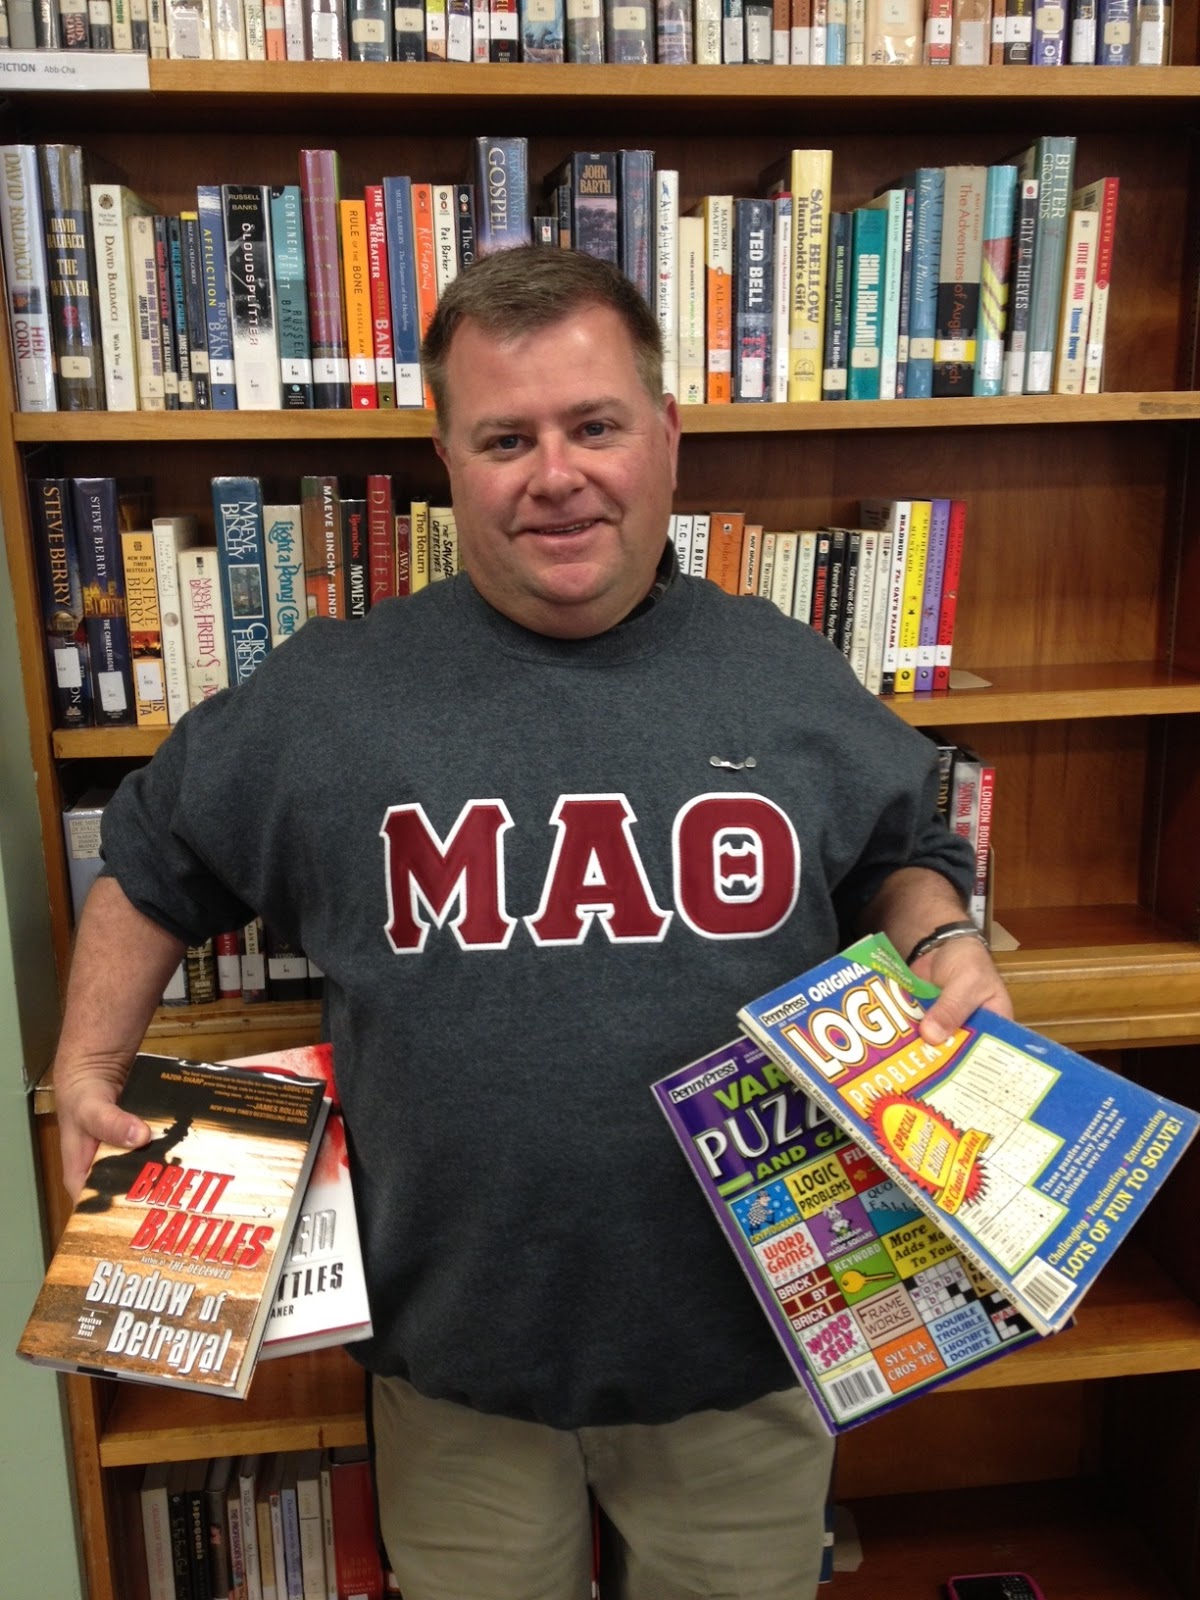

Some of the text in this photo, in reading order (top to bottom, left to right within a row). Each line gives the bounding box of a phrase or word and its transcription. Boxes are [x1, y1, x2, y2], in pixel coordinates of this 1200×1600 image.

[44, 65, 76, 74] Abb-Cha
[488, 147, 508, 236] GOSPEL
[580, 180, 611, 194] BARTH
[582, 164, 608, 180] JOHN
[1040, 153, 1054, 220] GROUNDS
[1052, 154, 1070, 220] BITTER
[4, 154, 33, 281] DAVID BALDACCI
[51, 218, 77, 233] DAVID
[374, 190, 384, 244] THE SWEET
[462, 227, 473, 249] The
[1101, 183, 1116, 274] ELIZABETH BERG
[48, 234, 85, 249] BALDACCI
[104, 235, 116, 271] DAVID
[350, 210, 363, 294] RULE BONE
[369, 222, 380, 279] HEREAFTER
[441, 228, 451, 271] Pat Barker
[794, 196, 809, 312] Humboldt's Gift
[807, 188, 822, 324] SAUL BELLOW
[914, 199, 930, 302] Sammler's Planet
[954, 183, 974, 300] The Adventures of
[1016, 218, 1034, 310] CITY OF THIEVES
[51, 280, 90, 297] WINNER
[57, 259, 78, 276] THE
[204, 228, 218, 308] AFFLICTION
[242, 222, 259, 346] CLOUDSPLITTER
[749, 230, 764, 307] TED BELL
[1069, 242, 1089, 334] LITTLE BIG MAN Thomas
[106, 272, 118, 322] BALDACCI
[139, 295, 150, 340] JAMES BALDWIN
[178, 334, 188, 355] JAMES
[43, 486, 72, 608] STEVE BERRY
[90, 496, 107, 578] STEVE BERRY
[220, 503, 248, 560] BINCHY
[238, 501, 258, 554] MAEVE
[323, 486, 336, 578] MAEVE BINCHY
[416, 512, 426, 574] The Return
[432, 520, 442, 574] DETECTIVES
[678, 523, 688, 546] T.C.
[696, 522, 707, 544] T.C.
[896, 515, 906, 562] BRADBURY
[907, 526, 916, 573] MUSTARD
[400, 550, 409, 583] AWAY
[830, 563, 841, 597] Fahrenheit
[127, 577, 146, 628] BERRY
[142, 576, 160, 626] STEVE
[350, 564, 366, 618] MOMENT
[830, 598, 838, 610] 451
[844, 566, 857, 631] Fahrenheit 451 Ray
[891, 587, 900, 611] CAT'S
[828, 614, 837, 628] Ray
[956, 782, 976, 818] SANDRA
[976, 786, 992, 878] LONDON BOULEVARD
[762, 994, 807, 1026] PennyPress
[781, 975, 926, 1081] LOGIC
[671, 1060, 736, 1102] PennyPress
[766, 1040, 794, 1071] ORIGINAL
[794, 1070, 810, 1088] LOGIC
[810, 1087, 846, 1125] PROBLEMS
[855, 1134, 870, 1150] JULY
[914, 1194, 942, 1224] EDITION
[892, 1108, 918, 1151] SPECIAL
[1041, 1095, 1115, 1194] These puzzles represent the
[757, 1146, 807, 1180] AND
[1051, 1108, 1119, 1200] very best Penny Press has
[1060, 1137, 1111, 1205] published over the
[125, 1161, 235, 1215] BRETT
[792, 1162, 840, 1195] LOGIC
[799, 1182, 851, 1212] PROBLEMS
[944, 1170, 967, 1212] 86 Classic
[1047, 1109, 1167, 1268] Challenging Fascinating Entertaining
[1062, 1115, 1184, 1279] LOTS OF FUN TO SOLVE!
[129, 1209, 275, 1269] BATTLES
[763, 1231, 806, 1260] WORD
[890, 1222, 928, 1247] More
[894, 1241, 925, 1261] Adds
[168, 1260, 186, 1271] THE
[768, 1245, 814, 1275] GAMES
[834, 1244, 882, 1273] KEYWORD
[910, 1255, 926, 1269] To
[86, 1261, 229, 1323] Shadow of
[777, 1276, 814, 1300] BRICK
[811, 1288, 828, 1300] BY
[859, 1295, 905, 1324] FRAME
[792, 1307, 827, 1331] BRICK
[806, 1313, 851, 1353] WORD
[866, 1307, 912, 1334] WORKS
[934, 1307, 978, 1332] DOUBLE
[936, 1313, 985, 1341] TROUBLE
[105, 1310, 234, 1375] Betrayal
[820, 1326, 858, 1368] SEEK
